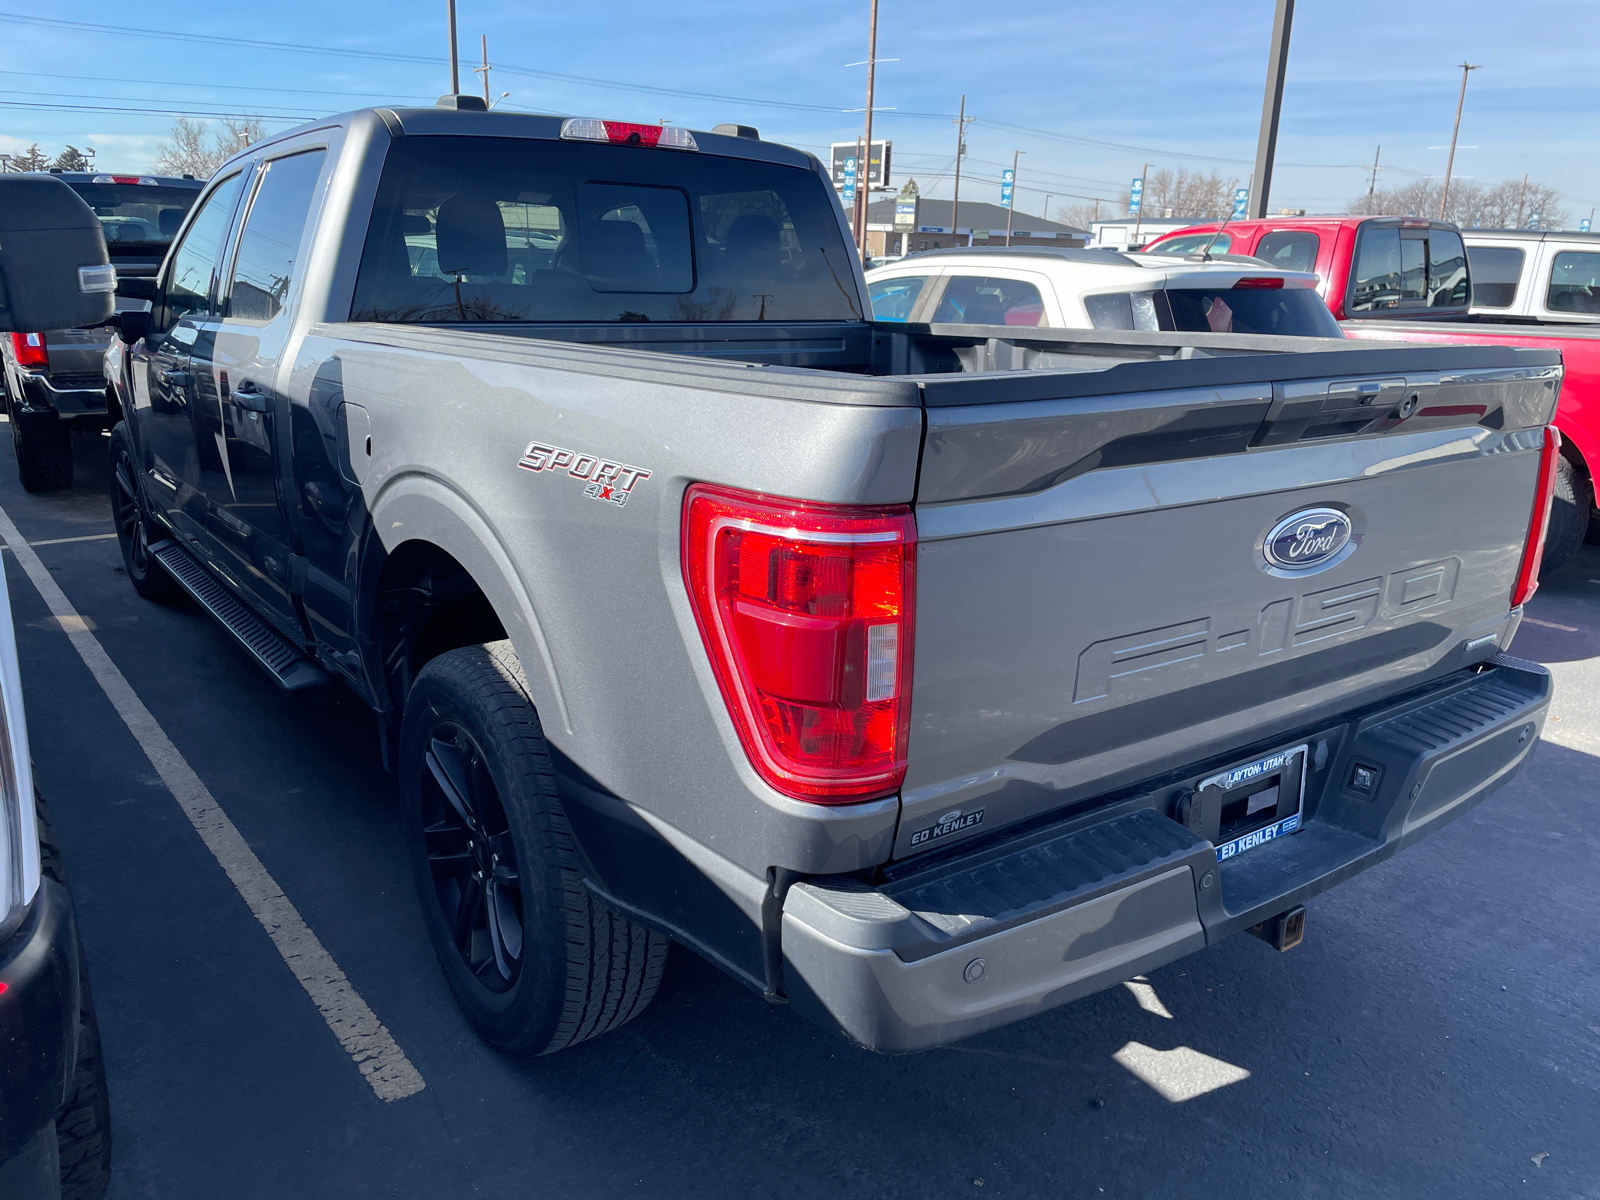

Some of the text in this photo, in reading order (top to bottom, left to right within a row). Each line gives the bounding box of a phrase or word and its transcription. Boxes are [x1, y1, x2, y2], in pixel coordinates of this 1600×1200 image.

[518, 441, 652, 492] SPORT
[1289, 518, 1338, 558] Ford
[1072, 555, 1463, 704] F-150
[1262, 755, 1284, 771] UTAH
[911, 811, 984, 845] ED KENLEY
[1221, 842, 1236, 860] ED
[1238, 824, 1279, 854] KENLEY
